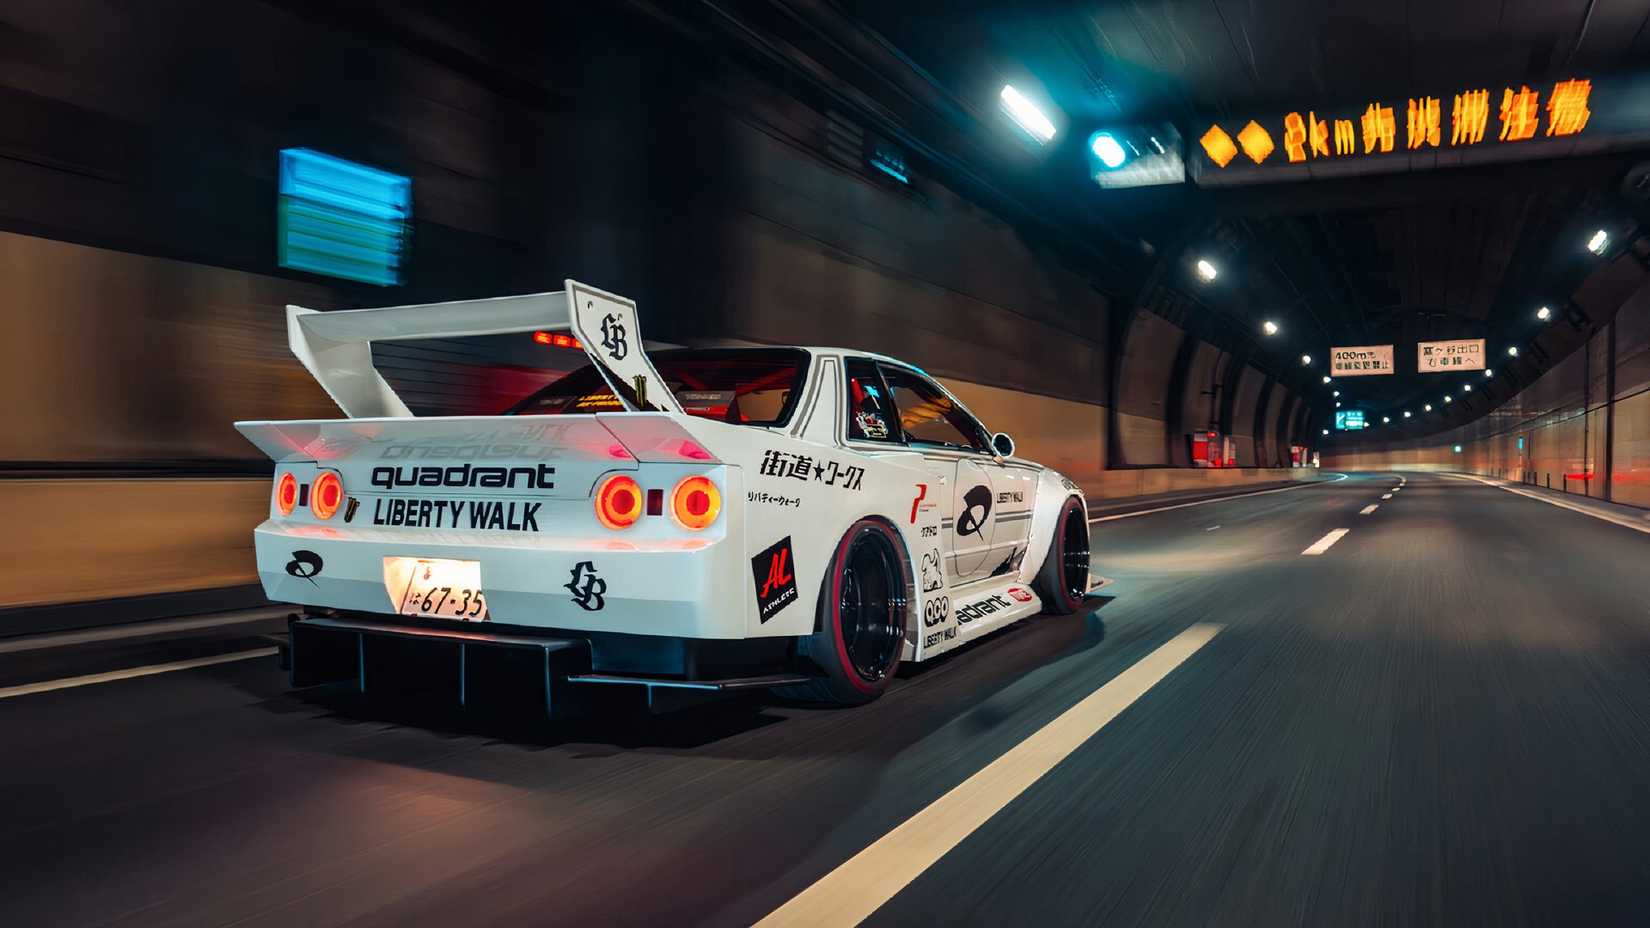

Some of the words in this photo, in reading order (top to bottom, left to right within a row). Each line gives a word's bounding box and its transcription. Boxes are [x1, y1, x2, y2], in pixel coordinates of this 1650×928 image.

[371, 463, 555, 489] quadrant
[373, 498, 465, 528] LIBERTY
[469, 501, 542, 532] WALK
[955, 594, 1012, 625] adrant
